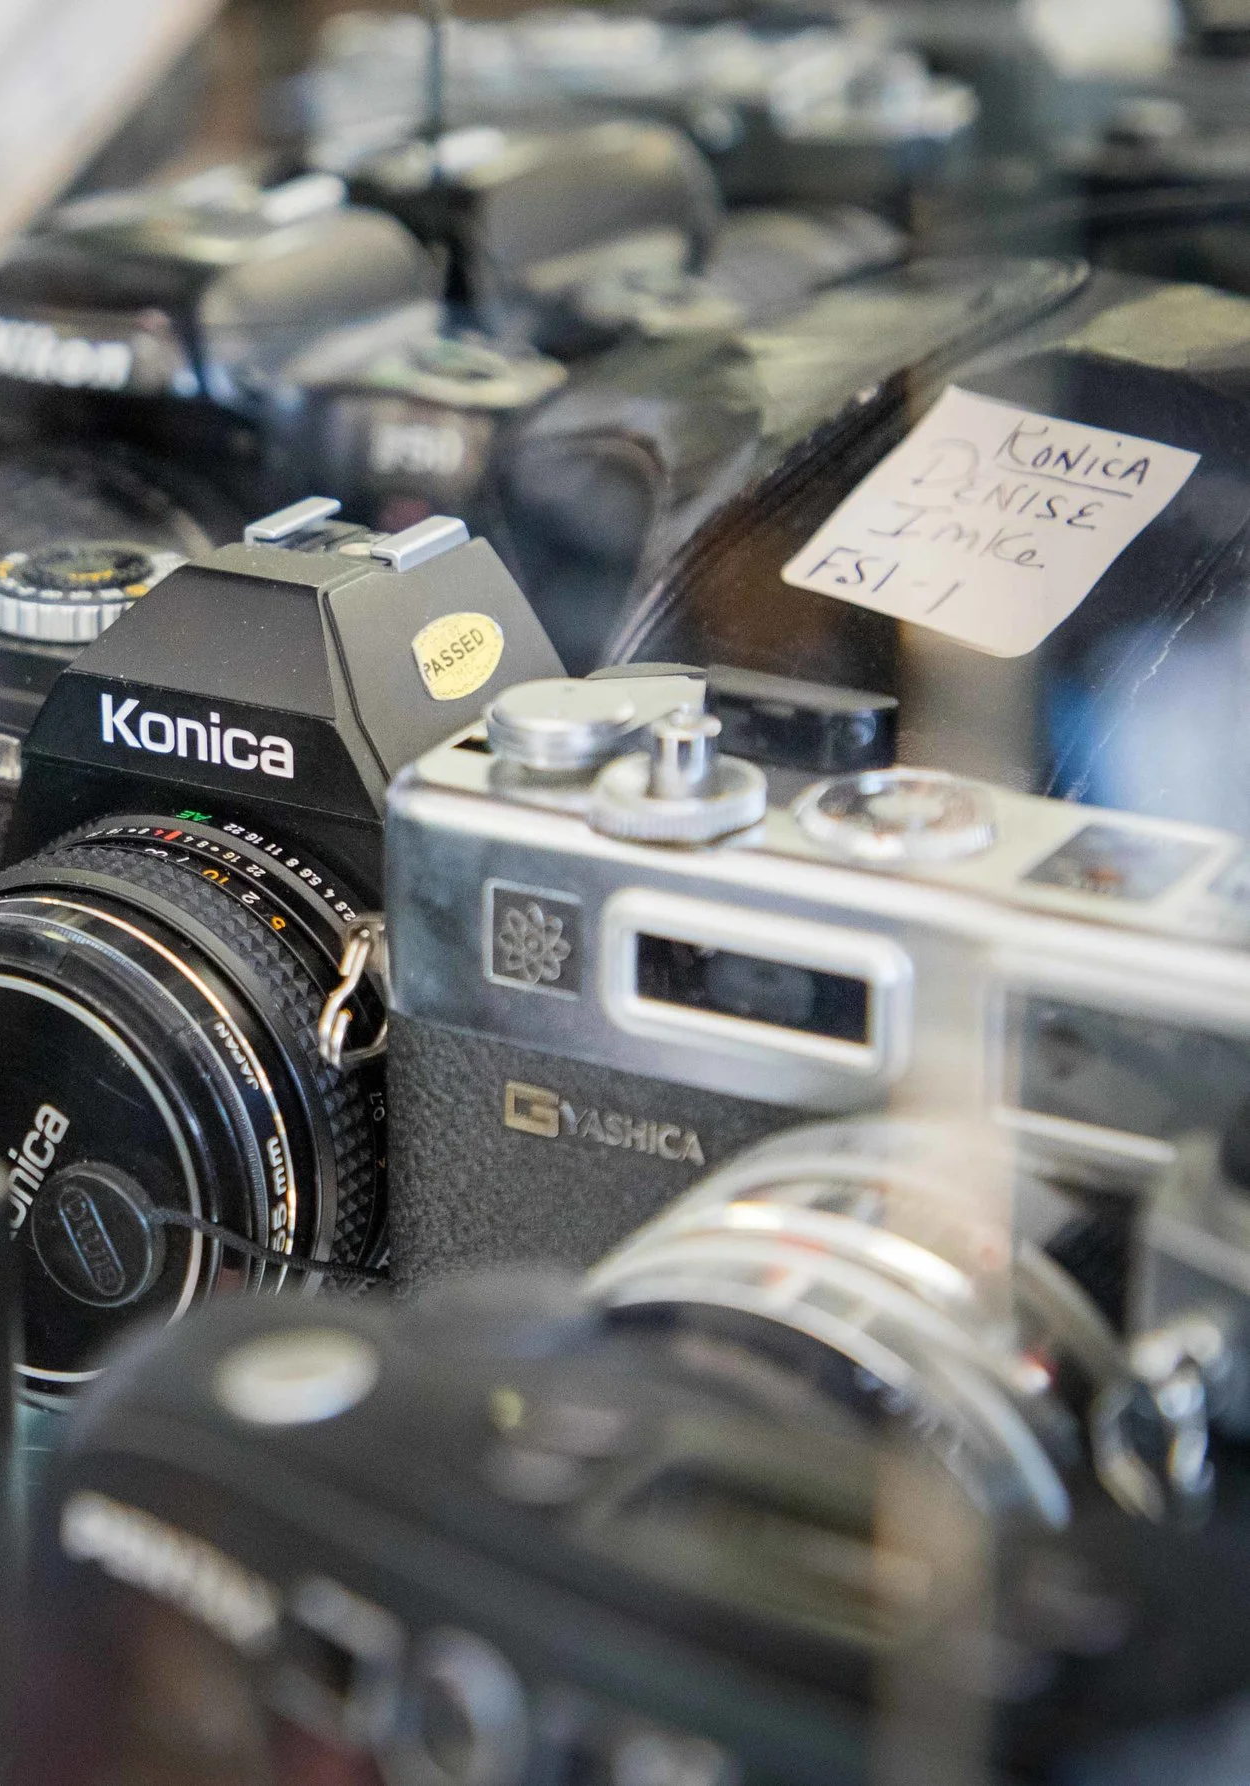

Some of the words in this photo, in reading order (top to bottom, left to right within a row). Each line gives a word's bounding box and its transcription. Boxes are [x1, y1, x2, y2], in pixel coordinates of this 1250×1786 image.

[423, 628, 485, 682] PASSED
[101, 693, 294, 779] Konica
[175, 810, 212, 822] AE
[223, 823, 245, 835] 22
[244, 832, 264, 844] 16
[264, 843, 283, 856] 11
[222, 851, 241, 863] 16
[285, 858, 300, 868] 8
[245, 864, 266, 877] 22
[299, 868, 322, 886] 5.6
[241, 890, 261, 904] 2
[324, 888, 336, 899] 4
[213, 1021, 259, 1091] JAPAN
[559, 1100, 706, 1167] YASHICA
[7, 1103, 70, 1240] onica
[266, 1136, 287, 1197] mm
